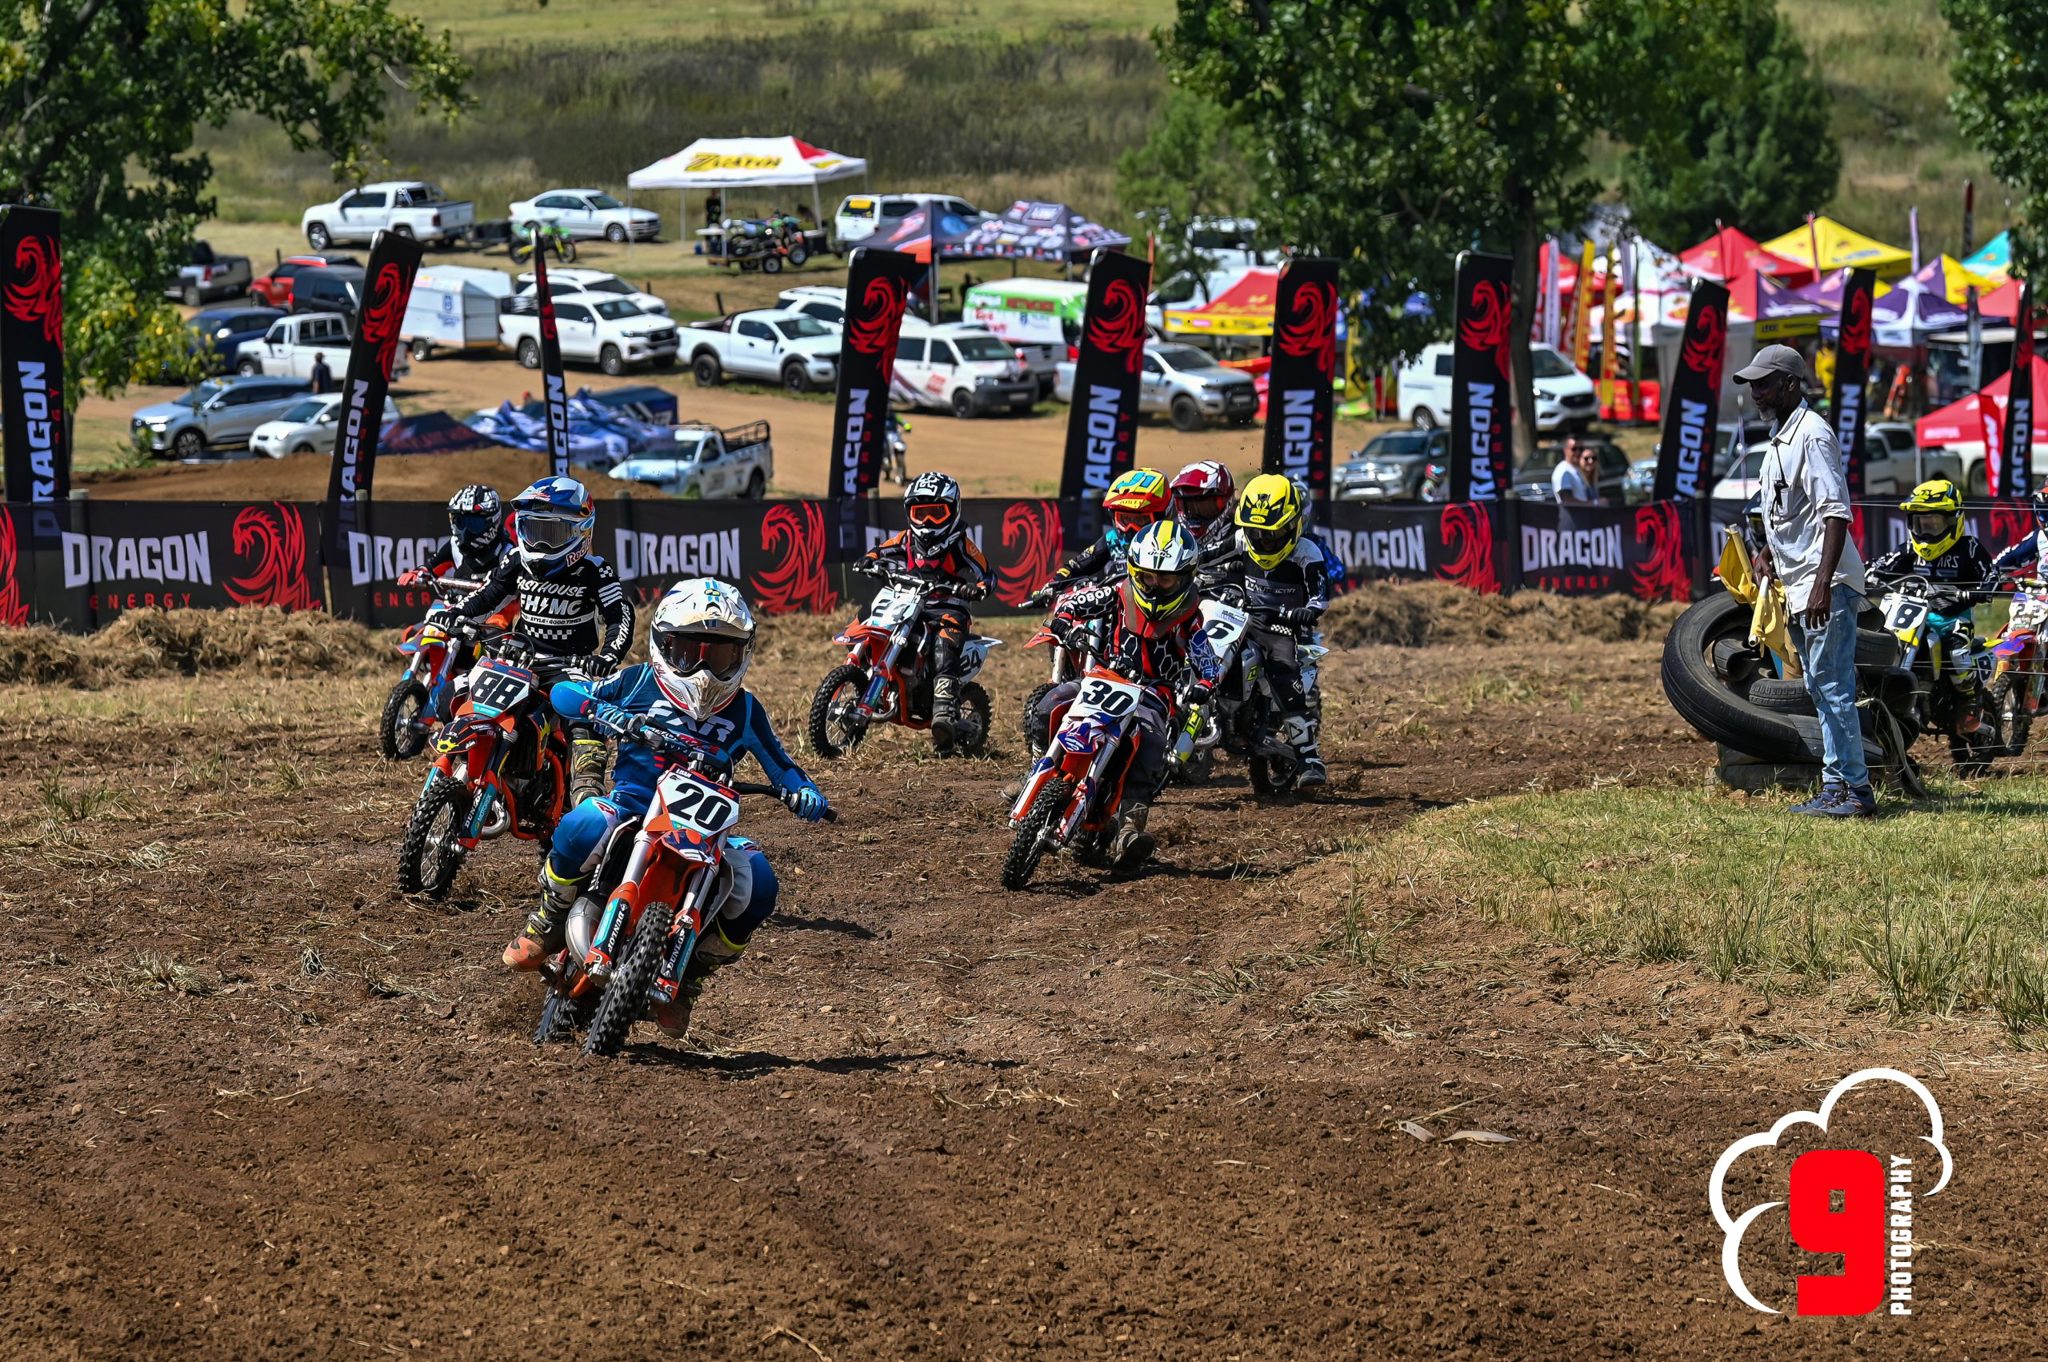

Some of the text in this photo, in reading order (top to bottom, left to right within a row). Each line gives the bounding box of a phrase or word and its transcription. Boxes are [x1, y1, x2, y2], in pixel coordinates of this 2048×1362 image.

[546, 374, 570, 478] AGON
[1283, 389, 1316, 482] AGON
[1467, 381, 1498, 501] RAGON
[1673, 398, 1709, 502] AGON
[2010, 398, 2030, 497] RAGON
[62, 531, 212, 589] DRAGON
[348, 531, 451, 587] DRAG
[615, 528, 741, 582] DRAGON
[1521, 524, 1623, 572] DRAGON
[89, 592, 192, 609] ENERGY
[373, 592, 431, 608] ENER
[517, 576, 588, 597] FASTHOUSE
[610, 602, 631, 651] FASTHOUSE
[1202, 620, 1235, 640] 6
[471, 670, 526, 711] 88
[1080, 680, 1134, 716] 30
[666, 783, 732, 831] 20
[607, 910, 625, 953] DUNLOP
